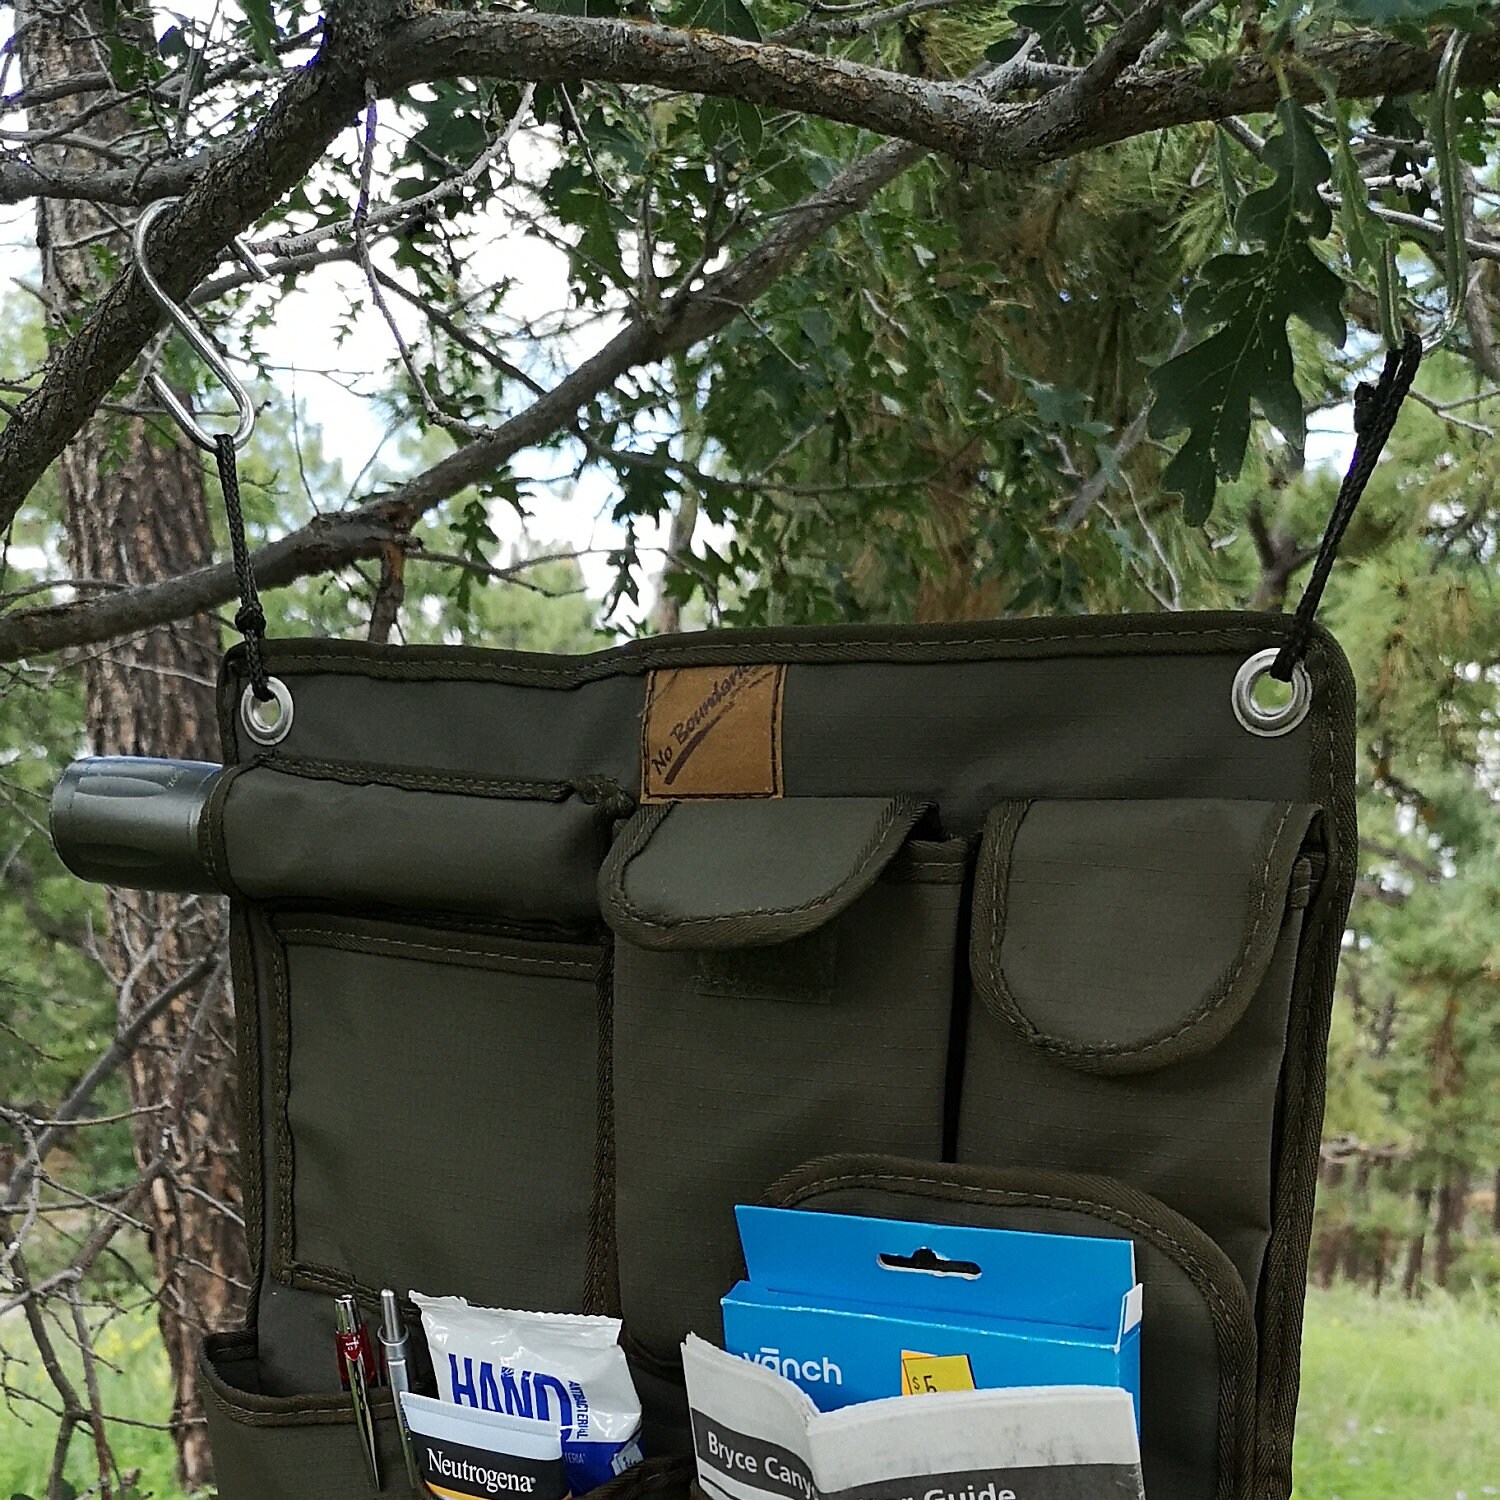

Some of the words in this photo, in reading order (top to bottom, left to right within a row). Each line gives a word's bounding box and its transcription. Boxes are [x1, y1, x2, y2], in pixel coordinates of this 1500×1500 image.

[652, 746, 673, 775] No
[448, 1353, 572, 1441] HAND
[427, 1448, 533, 1493] Neutrogena
[708, 1431, 758, 1473] Bryce
